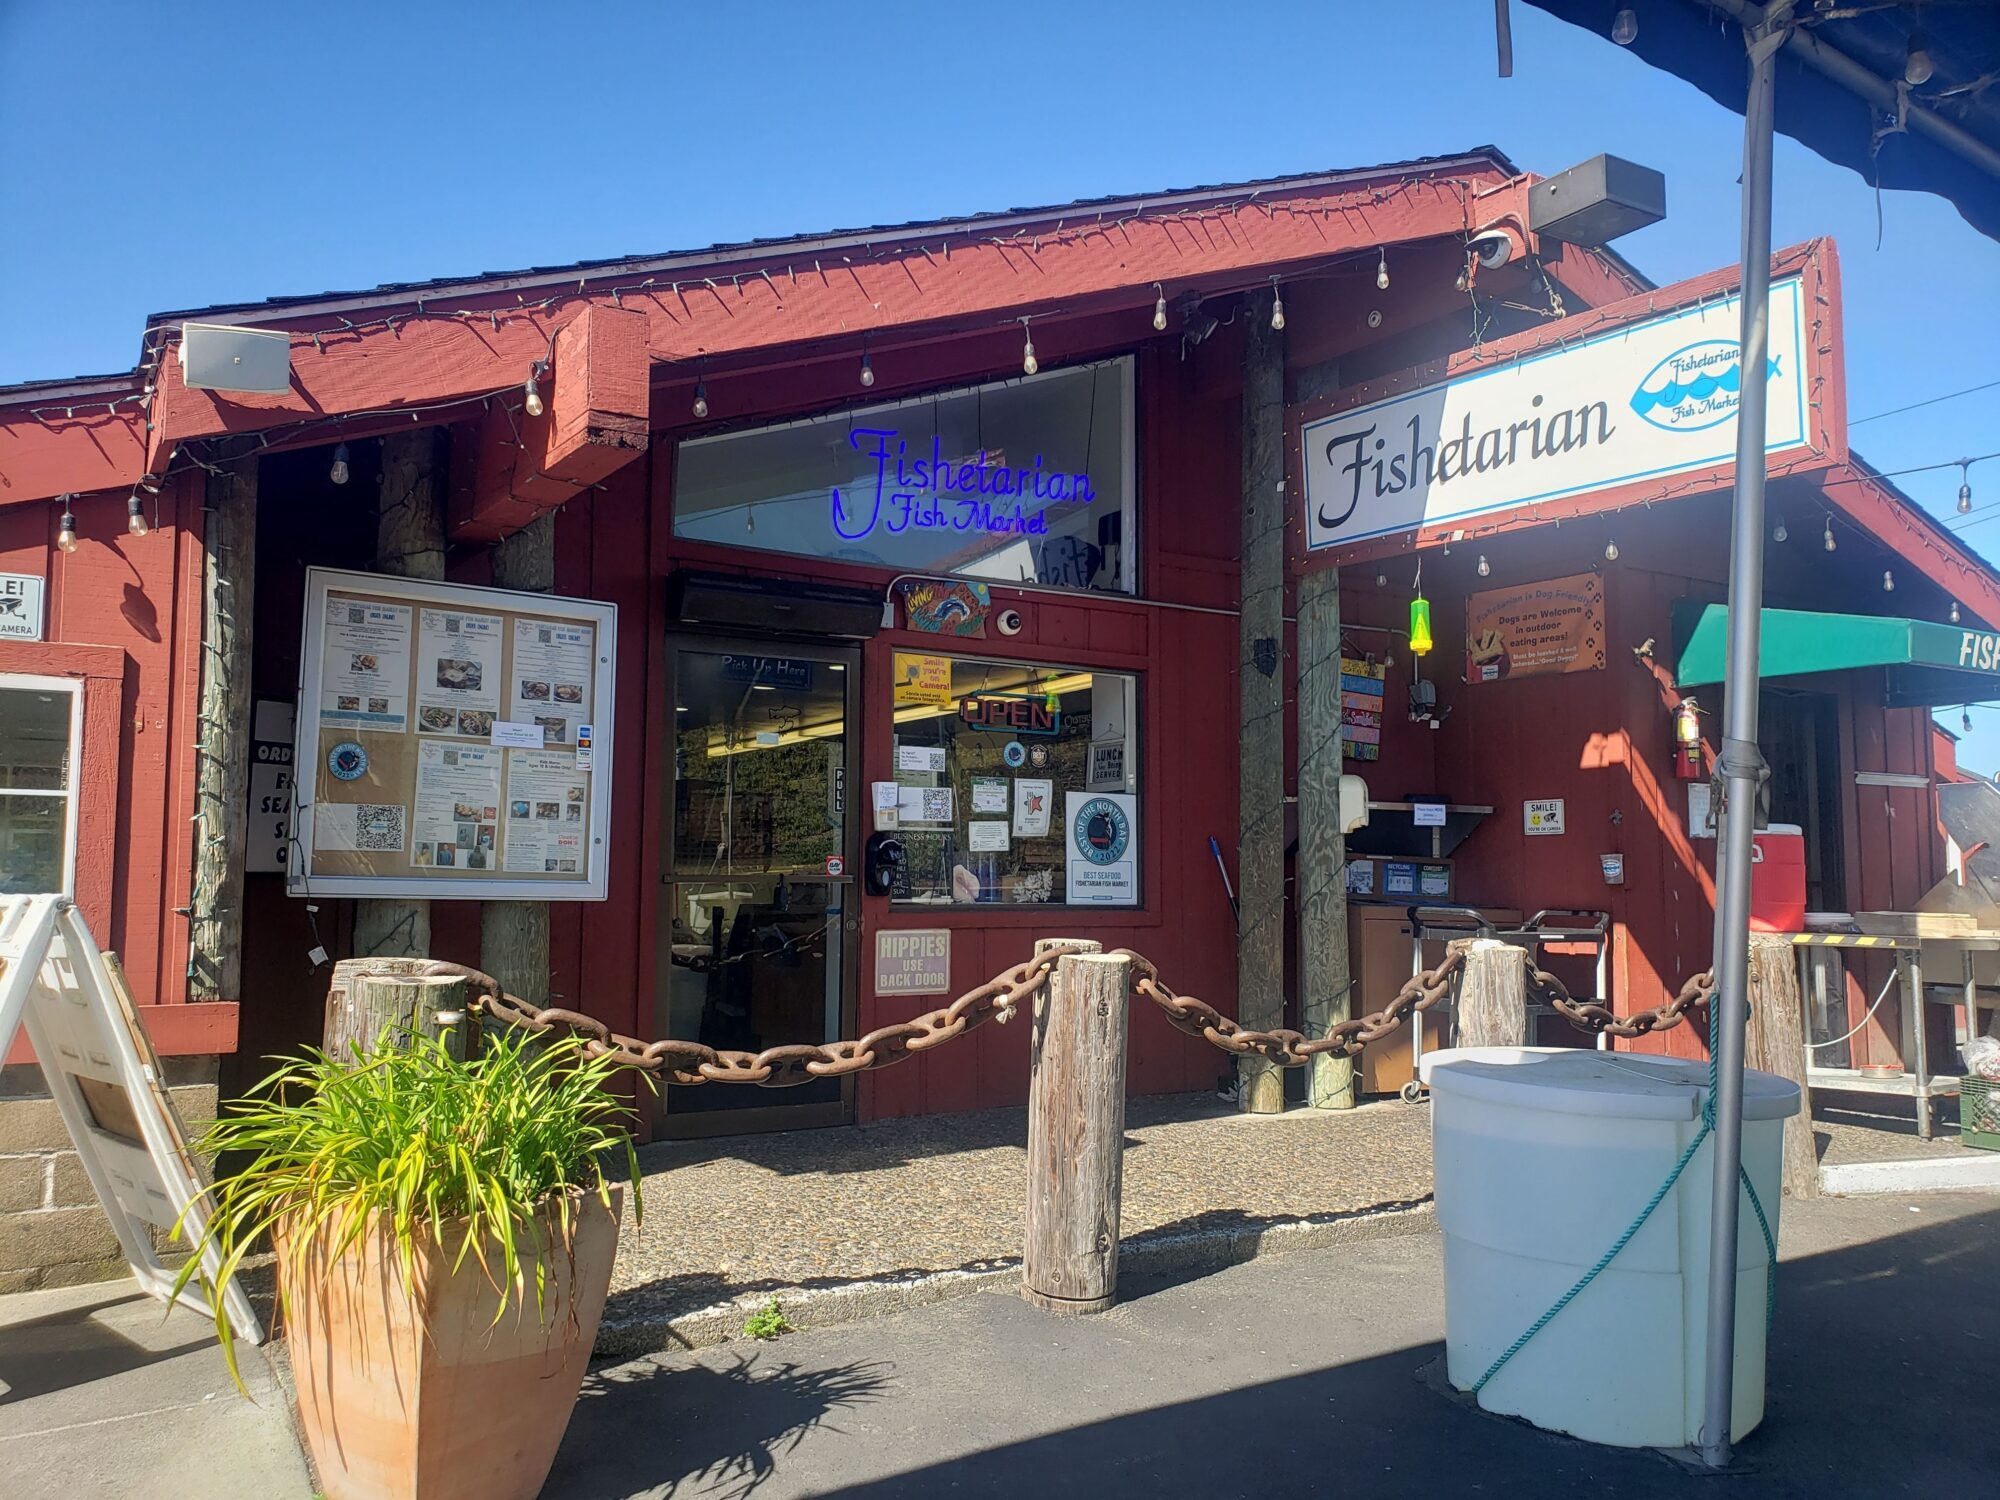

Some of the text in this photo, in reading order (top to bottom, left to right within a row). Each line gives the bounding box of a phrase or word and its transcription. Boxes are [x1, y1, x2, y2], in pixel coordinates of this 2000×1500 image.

[1671, 394, 1740, 423] Fish Marke
[1318, 394, 1616, 528] Fishetarian
[833, 428, 1096, 539] Fishetarian
[888, 493, 1048, 535] Fish Market
[908, 587, 934, 613] LIVING
[1535, 590, 1553, 600] Dog
[1499, 606, 1582, 625] Dogs are Welcome
[0, 624, 32, 634] AMERA
[1515, 621, 1562, 634] in outdoor
[1510, 632, 1568, 648] eating areas!
[721, 655, 806, 675] Pick Up Here
[923, 657, 945, 666] Smile
[919, 680, 950, 690] Camera!
[963, 697, 1052, 731] OPEN
[258, 745, 292, 761] ORD
[1096, 748, 1123, 762] LUNCH
[1095, 770, 1120, 779] SERVED
[836, 770, 844, 810] PULL
[1530, 803, 1557, 812] SMILE!
[893, 832, 925, 840] BUSINESS
[1077, 802, 1127, 858] BEST OF THE NORTH BAY
[1100, 845, 1121, 861] 2022
[1083, 871, 1122, 880] BEST SEAFOOD
[880, 936, 946, 958] HIPPIES
[902, 959, 924, 972] USE
[880, 972, 945, 987] BACK DOOR
